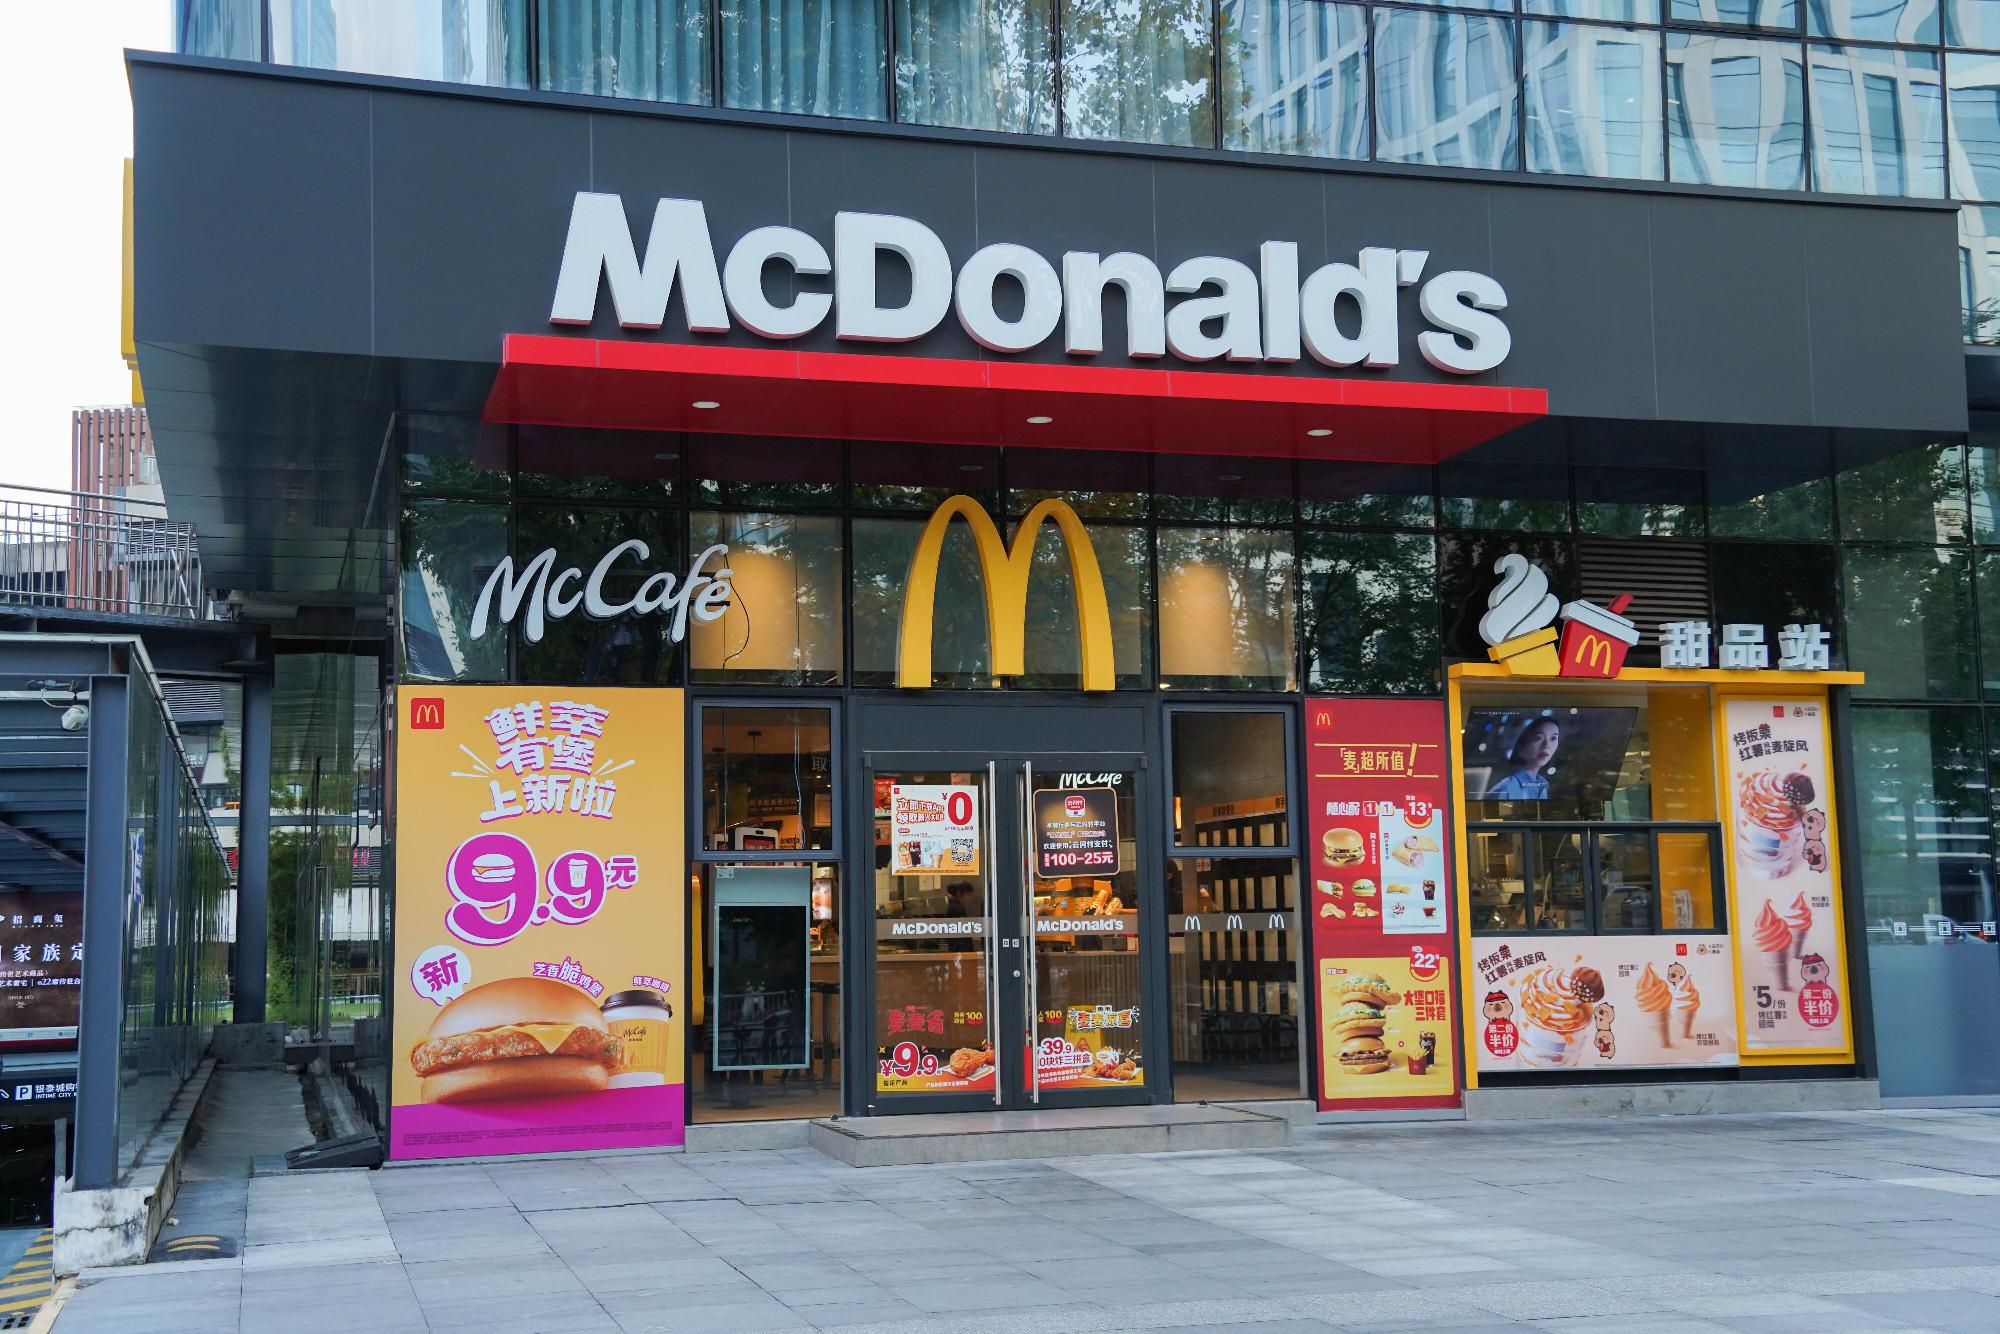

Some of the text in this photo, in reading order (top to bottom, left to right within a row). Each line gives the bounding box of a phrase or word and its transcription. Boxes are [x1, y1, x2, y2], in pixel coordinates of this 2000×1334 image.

[549, 191, 1512, 375] McDonald's
[470, 539, 733, 643] McCafé
[1659, 620, 1831, 671] 甜品站
[484, 701, 609, 743] 鲜萃
[1733, 723, 1772, 746] 烤板栗
[496, 735, 595, 775] 有堡
[480, 774, 616, 823] 上新啦
[892, 922, 983, 935] McDonald's
[1036, 918, 1124, 932] McDonald's
[0, 943, 83, 963] 家族定
[1477, 944, 1512, 973] 烤板栗
[420, 952, 459, 993] 新
[533, 956, 604, 998] 芝香脆鸡堡
[1803, 988, 1832, 999] 第二份
[1415, 1006, 1446, 1022] 三件套
[1804, 1000, 1833, 1016] 半价
[1488, 1023, 1514, 1033] 第二份
[1489, 1033, 1514, 1047] 半价
[1037, 1053, 1091, 1067] 0块炸三拼盒
[35, 1083, 78, 1094] 银泰城购
